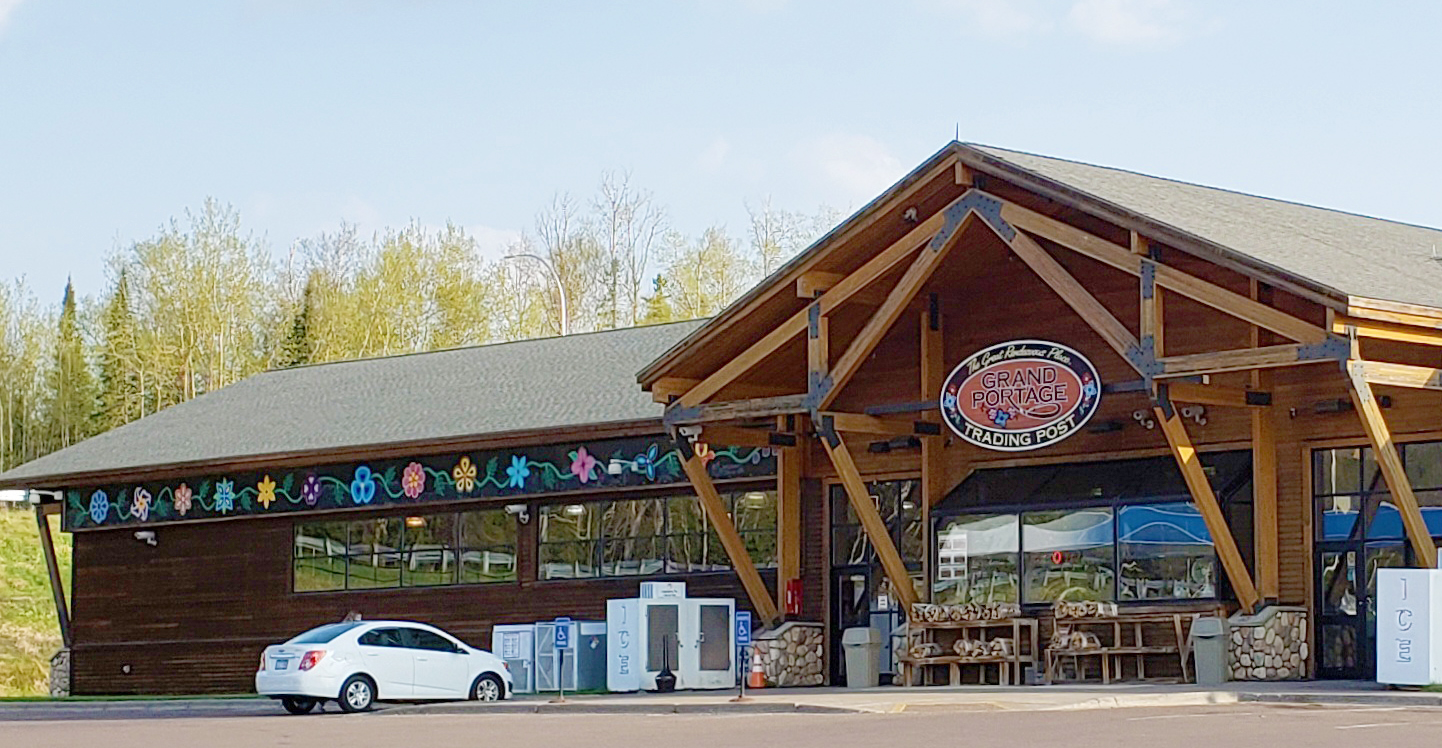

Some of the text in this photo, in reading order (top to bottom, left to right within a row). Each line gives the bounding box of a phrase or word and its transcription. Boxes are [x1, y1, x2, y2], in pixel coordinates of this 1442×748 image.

[966, 357, 981, 376] The
[981, 350, 1005, 367] Great
[981, 365, 1057, 389] GRAND
[971, 383, 1068, 410] PORTAGE
[963, 414, 1077, 447] TRADING POST
[1395, 577, 1413, 663] ICE
[618, 605, 630, 675] ICE
